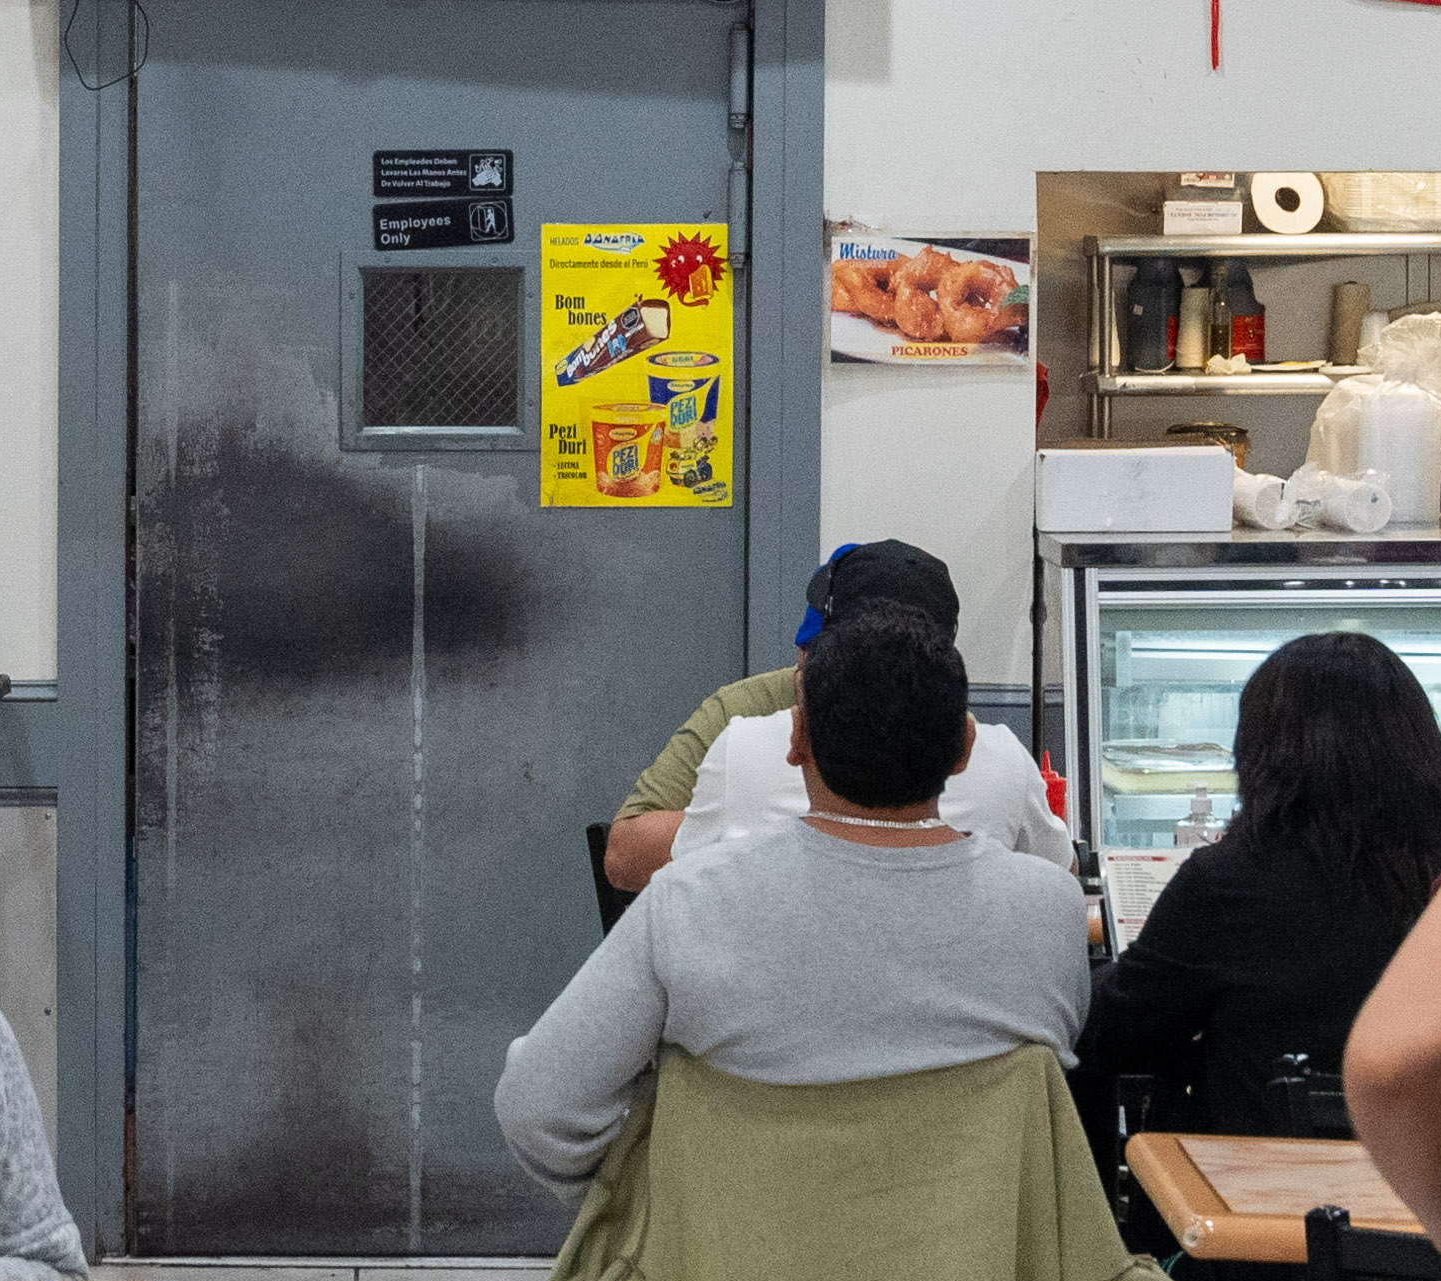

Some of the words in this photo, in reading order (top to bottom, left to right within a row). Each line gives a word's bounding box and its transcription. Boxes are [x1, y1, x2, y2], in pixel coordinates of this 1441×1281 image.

[379, 216, 452, 230] Employees
[381, 233, 411, 245] Only
[550, 237, 579, 246] HELADOS
[839, 242, 896, 260] Mistura
[549, 259, 599, 269] Directamente
[600, 259, 622, 269] desde
[624, 259, 631, 269] el
[632, 258, 648, 269] Perú
[555, 294, 585, 310] Bom
[568, 310, 607, 326] bones
[891, 346, 968, 357] PICARONES
[670, 396, 697, 415] PEZI
[549, 423, 577, 439] Pezi
[558, 438, 587, 455] Duri
[612, 444, 639, 462] PEZI
[557, 472, 587, 480] TRICOLOR
